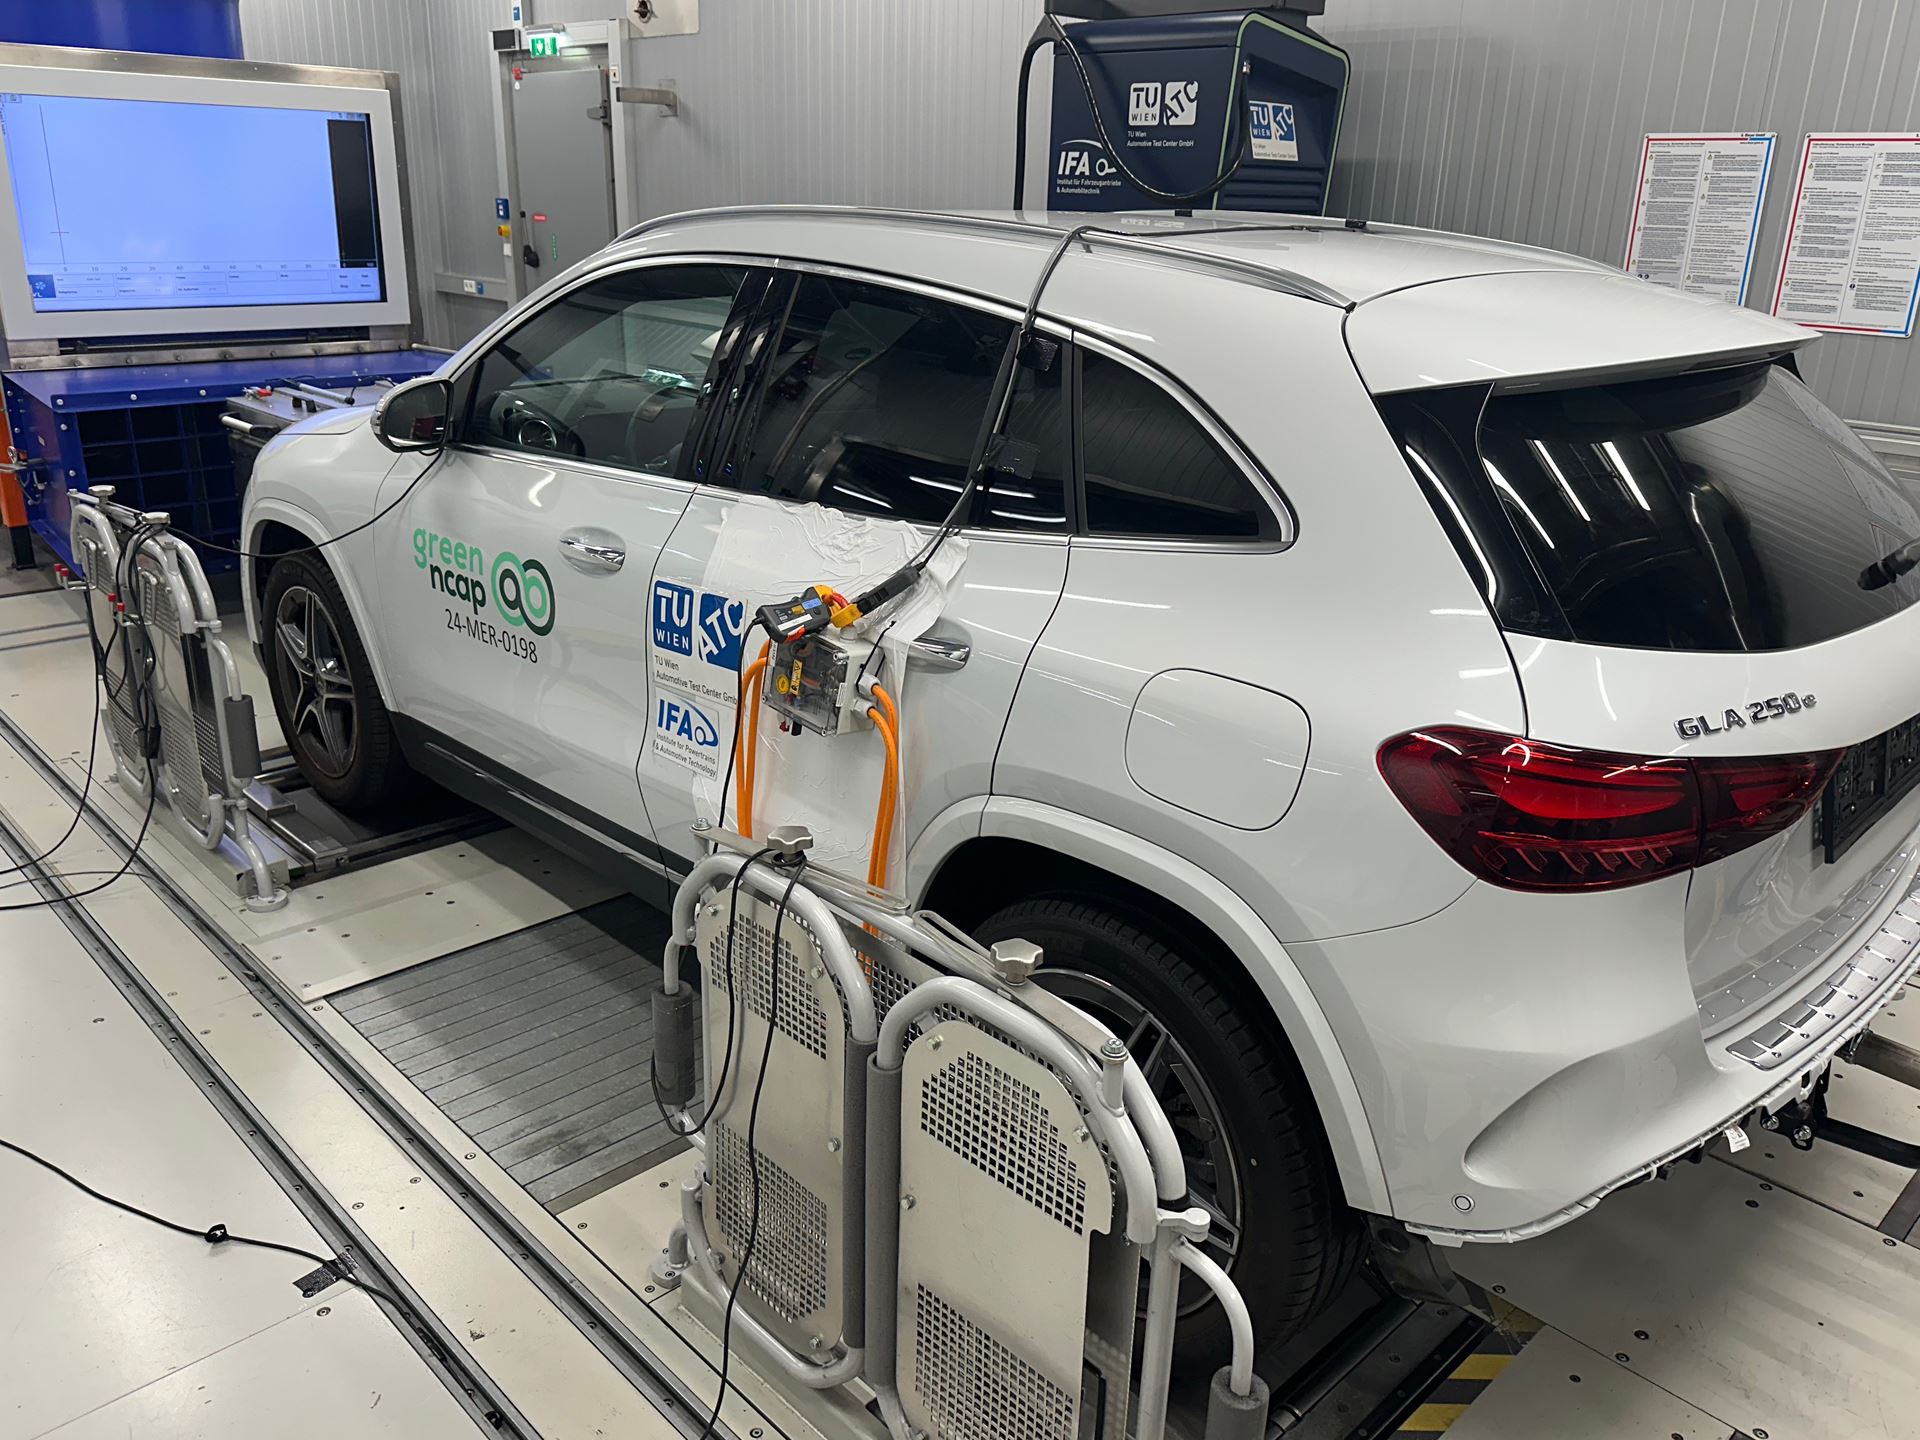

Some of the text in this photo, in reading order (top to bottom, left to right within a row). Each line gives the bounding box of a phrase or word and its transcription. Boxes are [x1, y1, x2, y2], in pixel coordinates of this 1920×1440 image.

[1132, 87, 1158, 108] TU
[1164, 81, 1198, 125] ATC
[1131, 113, 1157, 122] WIEN
[1250, 105, 1269, 125] TU
[1273, 106, 1295, 140] ATC
[1127, 130, 1135, 138] TU
[1127, 139, 1152, 147] Automotive
[1252, 128, 1270, 136] WIEN
[1057, 151, 1090, 176] IFA
[1080, 178, 1122, 187] Fahrzeugantriebe
[413, 528, 484, 576] green
[430, 563, 487, 616] ncap
[656, 586, 690, 628] TU
[445, 608, 538, 663] 24-MER-0198
[656, 628, 689, 650] WIEN
[699, 599, 745, 661] ATC
[654, 654, 680, 671] TU Wien
[656, 669, 738, 706] Automotive Test Center Gmb
[657, 698, 693, 742] IFA
[1674, 708, 1747, 740] GLA
[655, 742, 717, 778] & Automotive Technology
[656, 731, 716, 765] Institute for Powertrains
